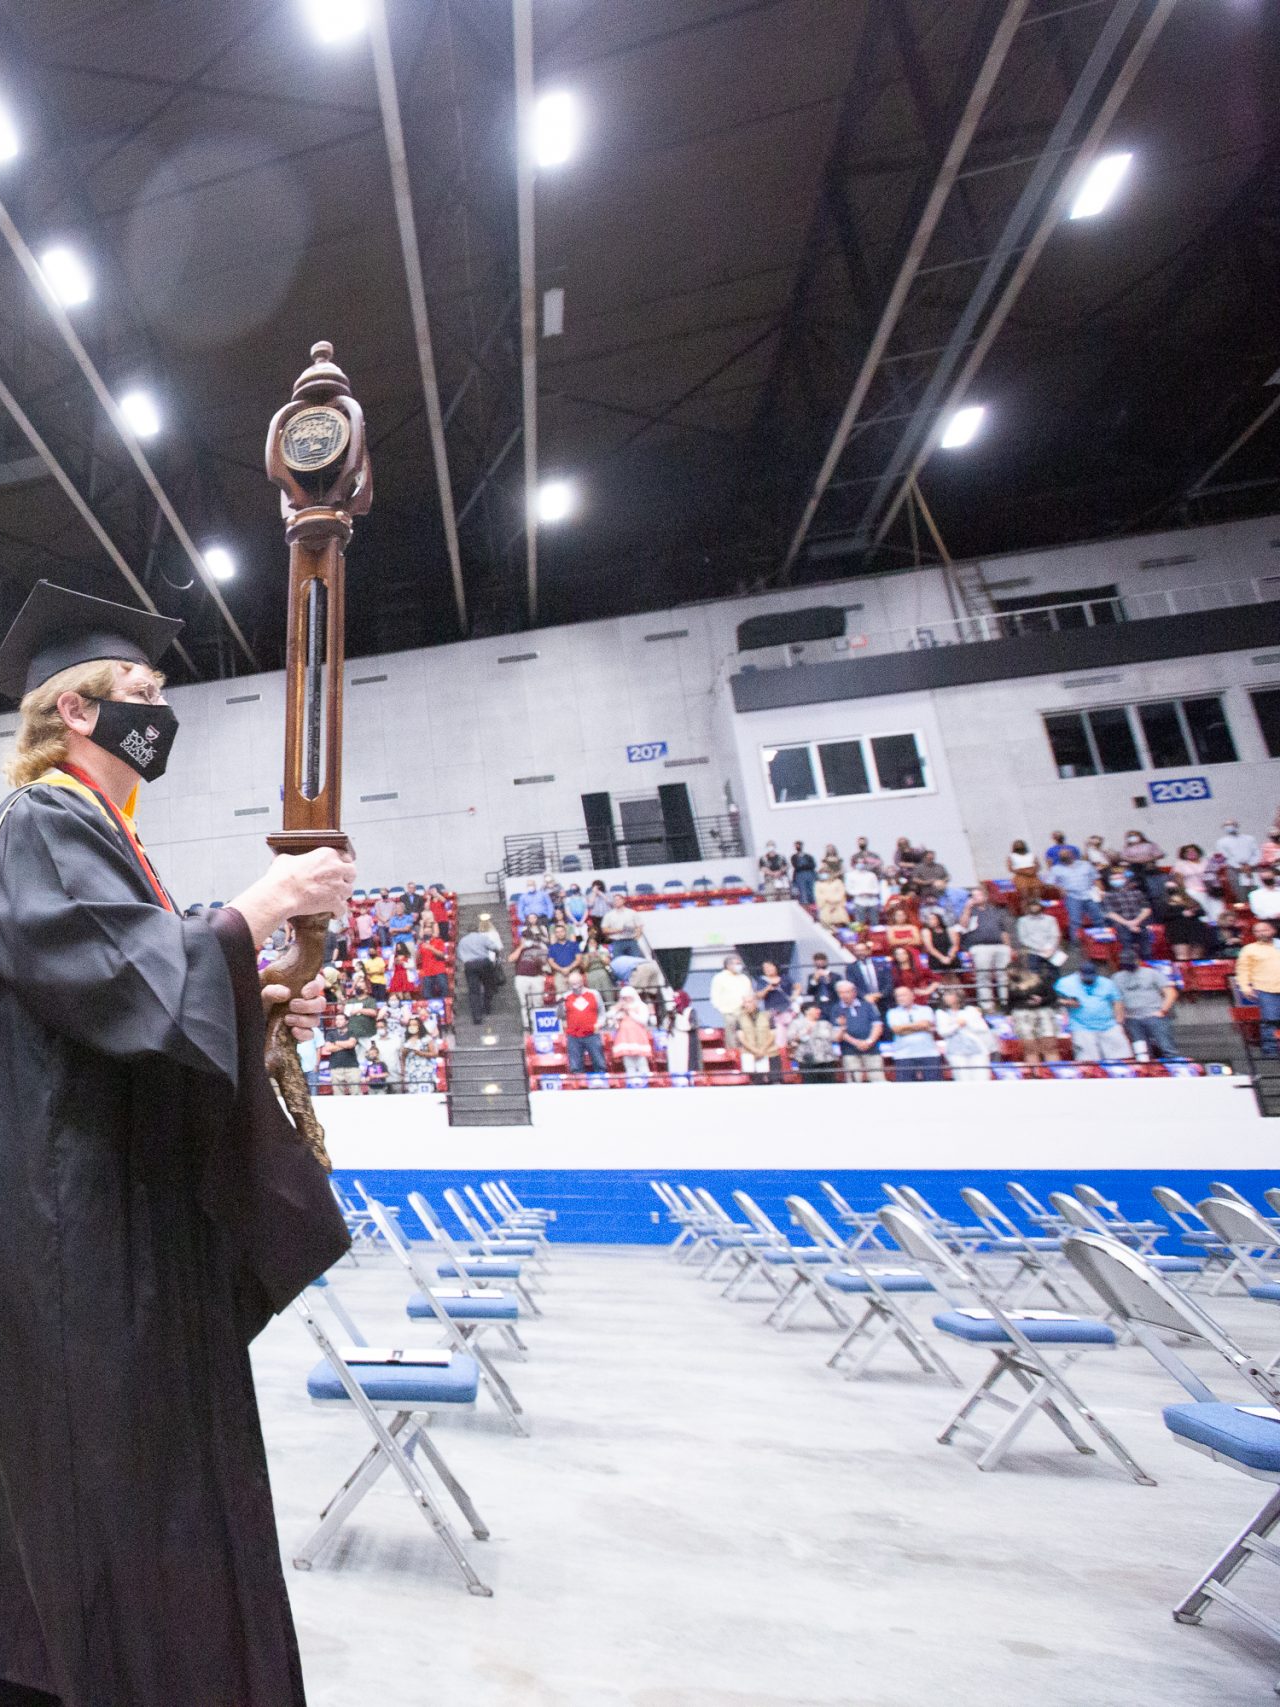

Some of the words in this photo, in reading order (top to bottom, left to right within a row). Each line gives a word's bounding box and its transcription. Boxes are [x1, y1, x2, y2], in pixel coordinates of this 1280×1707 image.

[120, 740, 148, 768] COLLEGE
[122, 735, 154, 764] STATE
[128, 729, 157, 757] POLK
[630, 745, 662, 760] 207
[1152, 781, 1206, 800] 208
[538, 1016, 558, 1028] 107
